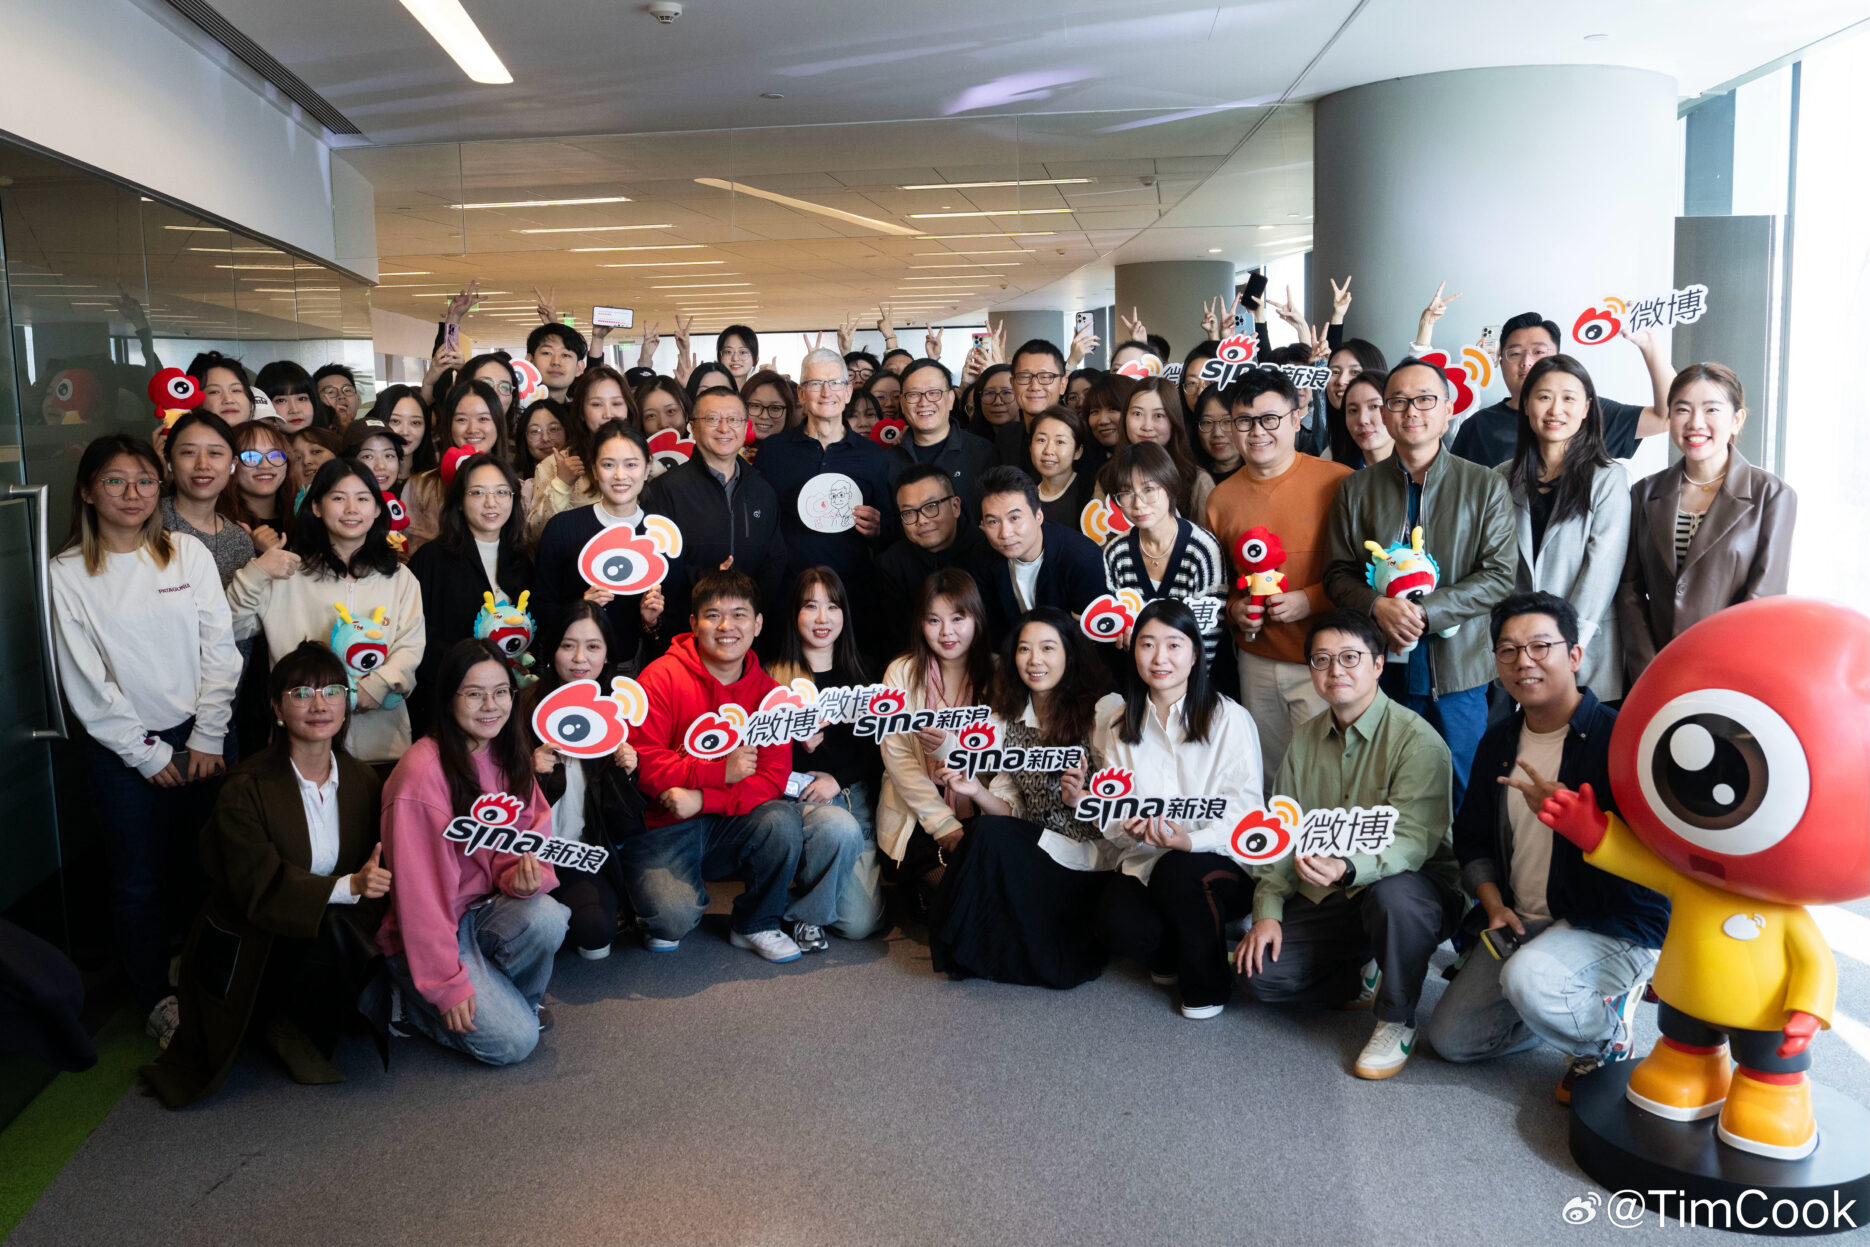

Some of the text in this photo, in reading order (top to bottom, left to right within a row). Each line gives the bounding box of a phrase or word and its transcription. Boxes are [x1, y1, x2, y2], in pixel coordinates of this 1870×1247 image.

[1629, 288, 1703, 333] 微博
[1282, 366, 1330, 388] 新浪
[746, 708, 820, 746] 微博
[856, 707, 990, 743] sina 新浪
[949, 747, 1082, 780] sina 新浪
[1077, 797, 1227, 830] sina 新浪
[1300, 810, 1393, 853] 微博
[446, 818, 606, 871] sina 新浪
